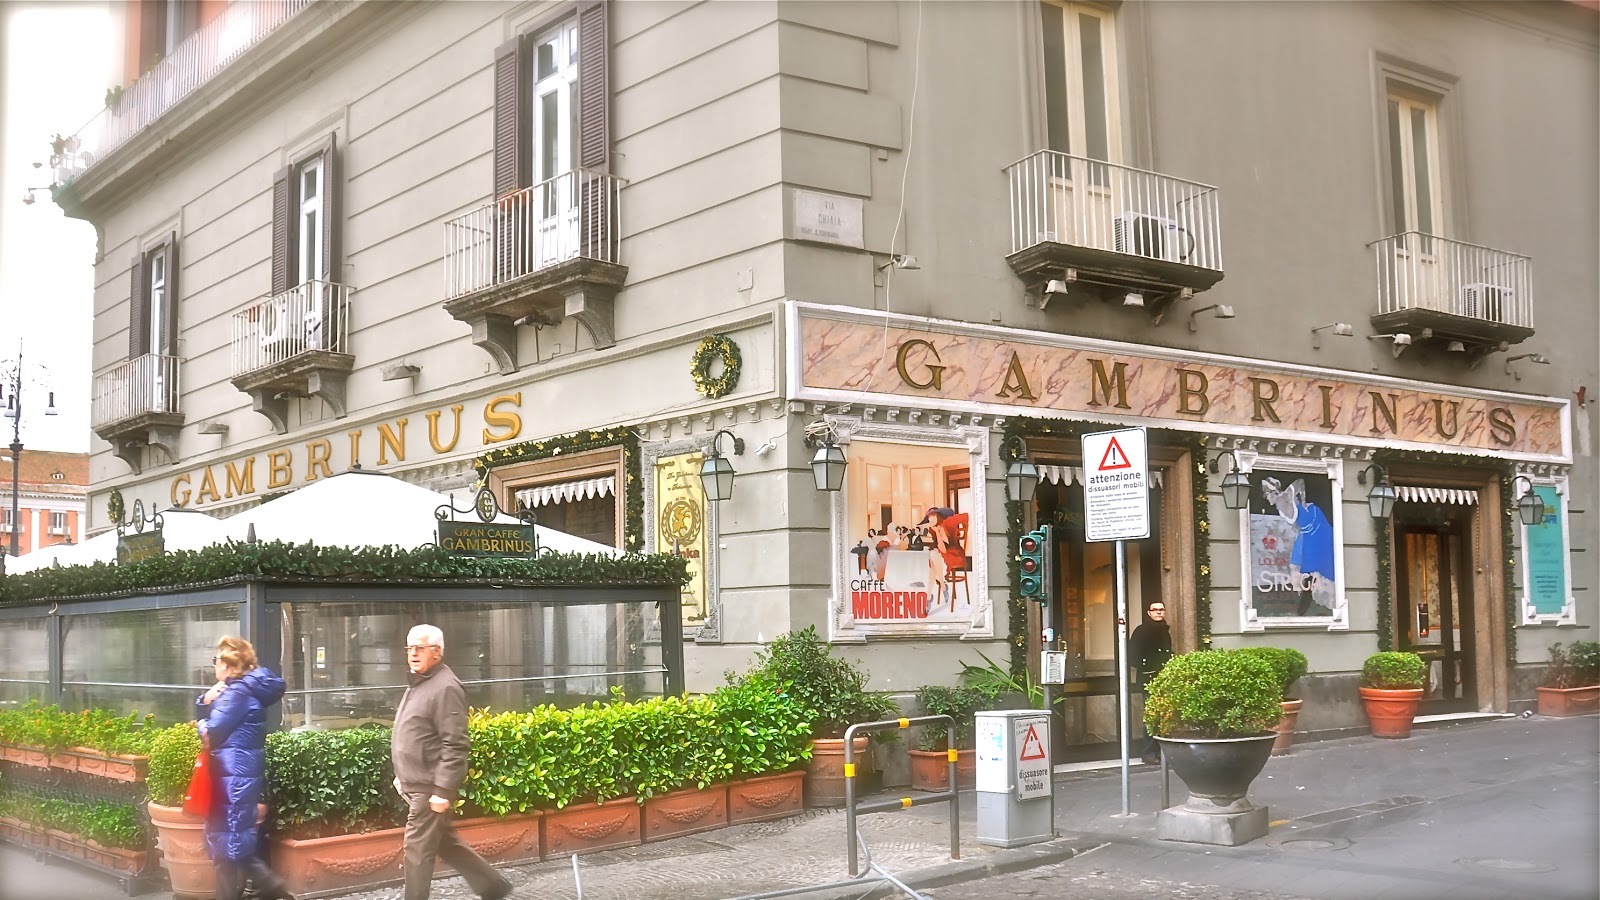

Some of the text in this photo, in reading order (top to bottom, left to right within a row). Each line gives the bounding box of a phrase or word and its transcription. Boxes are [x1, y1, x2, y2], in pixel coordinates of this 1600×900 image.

[825, 201, 835, 210] VIA
[896, 338, 1517, 447] GAMBRINUS
[170, 391, 523, 508] GAMBRINUS
[1090, 471, 1141, 483] attenzione
[1088, 481, 1144, 493] dissuasori mobili
[454, 528, 484, 537] GRAN
[442, 537, 533, 553] GAMBRINUS
[852, 591, 928, 619] MORENO
[1019, 768, 1048, 779] dissuasore
[1025, 780, 1044, 791] mobile
